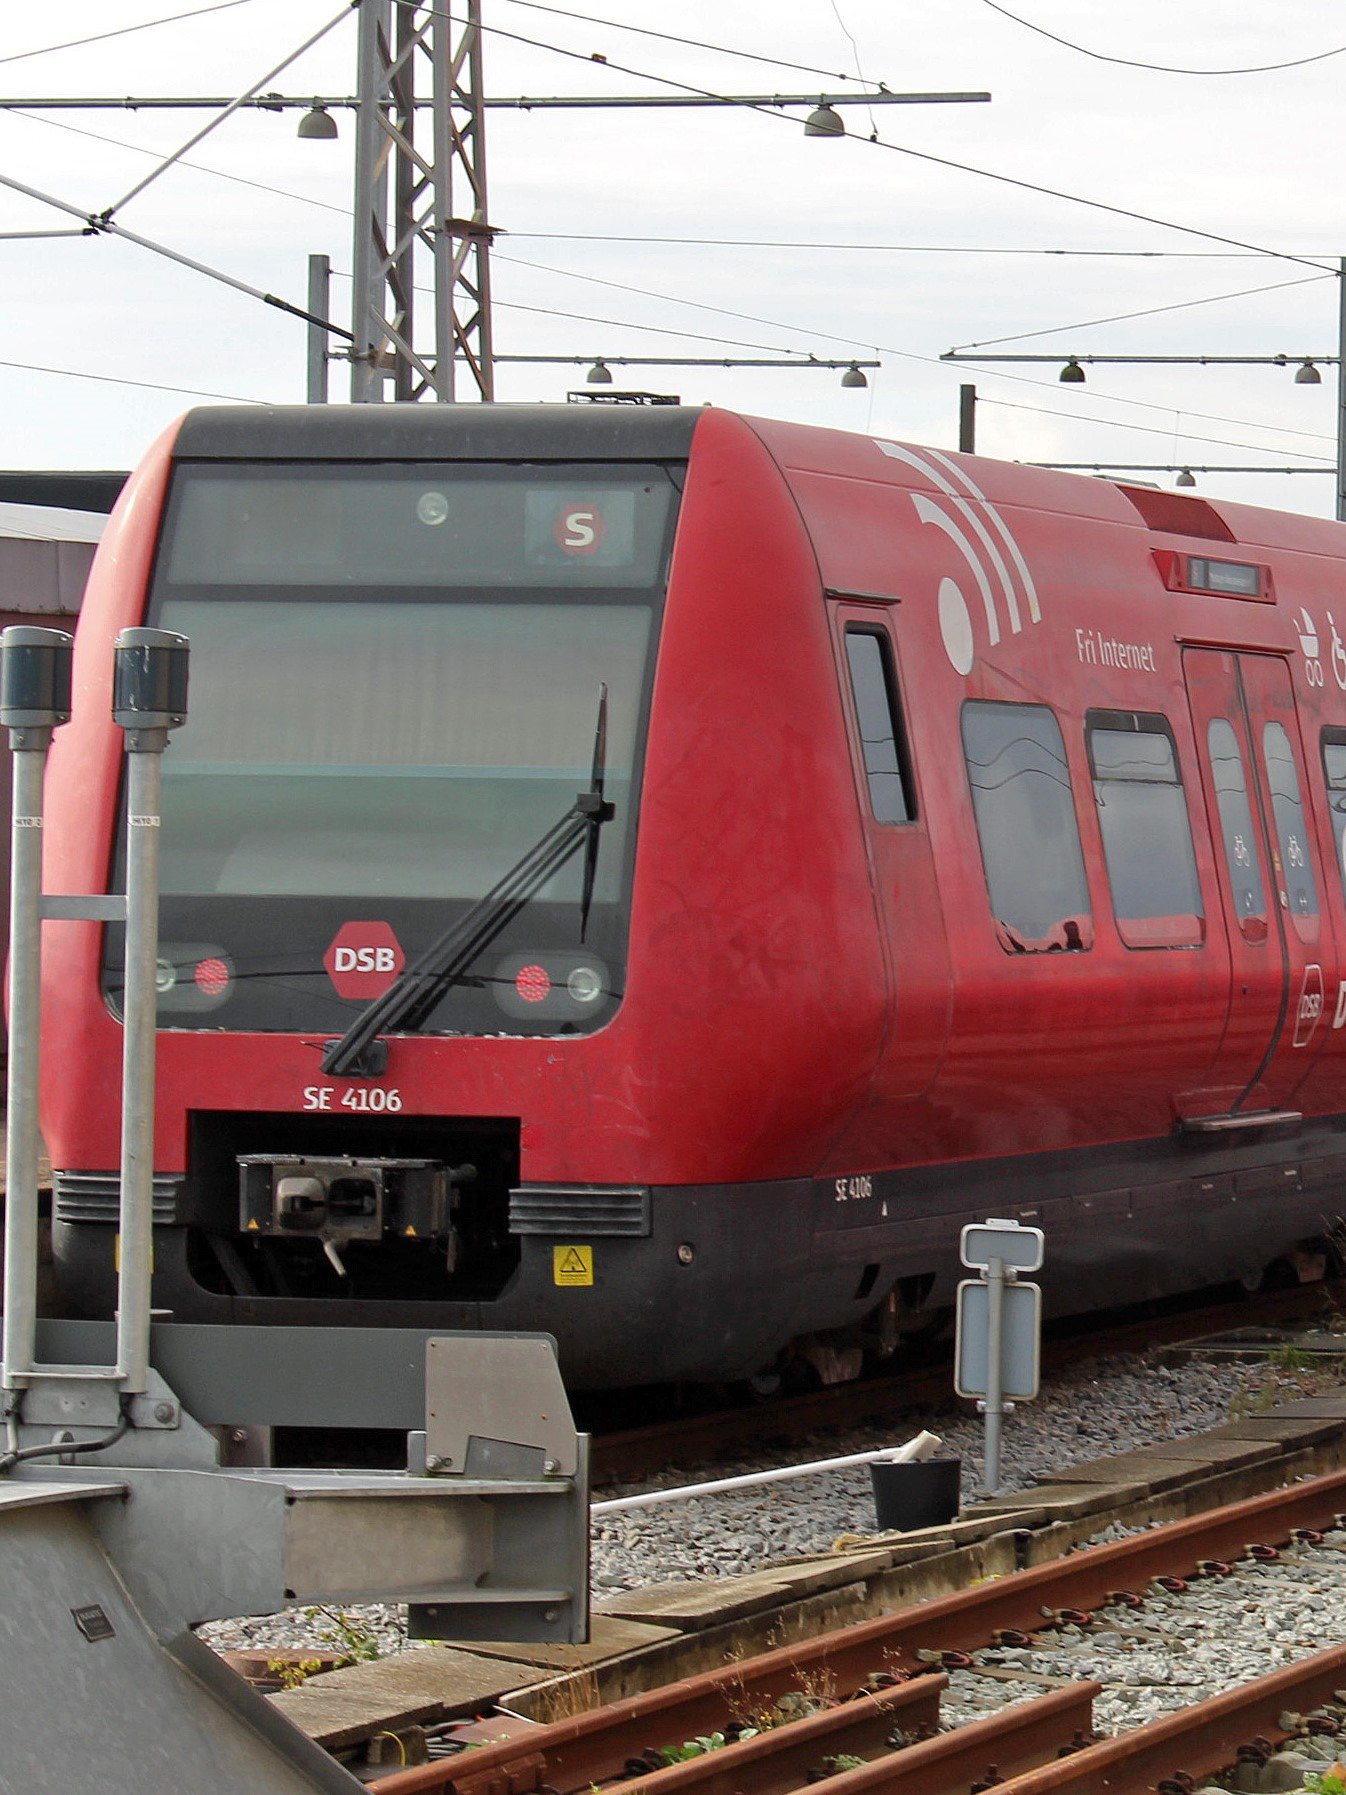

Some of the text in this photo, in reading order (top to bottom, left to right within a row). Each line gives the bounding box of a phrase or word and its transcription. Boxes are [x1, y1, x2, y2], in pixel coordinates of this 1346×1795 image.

[564, 512, 595, 547] S
[1075, 629, 1156, 672] Fri Internet
[334, 947, 396, 973] DSB
[1300, 993, 1321, 1019] DSB
[303, 1086, 403, 1112] SE 4106
[835, 1176, 872, 1202] SE 4106
